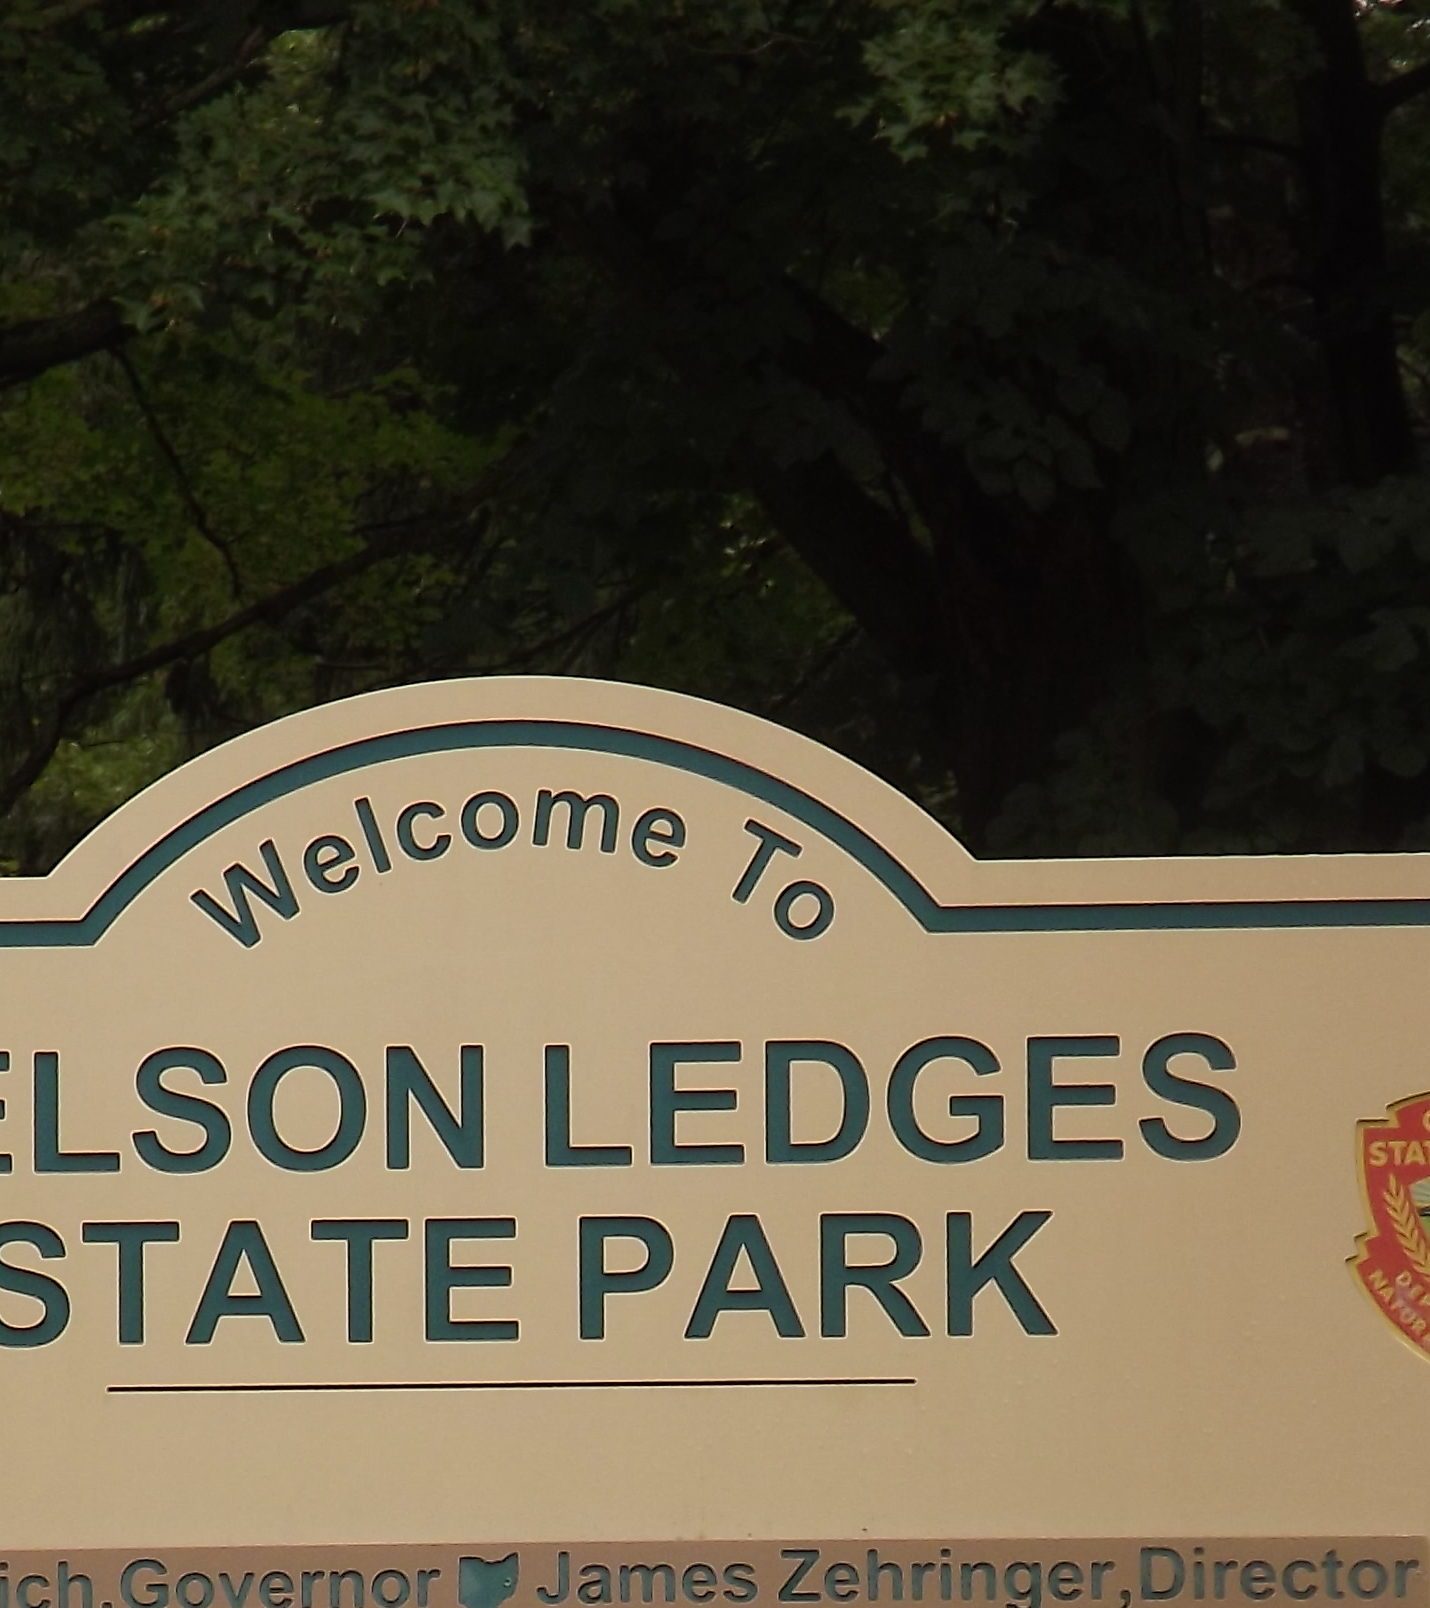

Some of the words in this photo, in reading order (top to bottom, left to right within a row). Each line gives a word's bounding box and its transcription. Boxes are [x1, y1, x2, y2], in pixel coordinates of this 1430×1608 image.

[189, 788, 689, 950] Welcome
[729, 818, 837, 943] To
[544, 1032, 1243, 1167] LEDGES
[578, 1211, 1058, 1341] PARK
[534, 1550, 758, 1605] James
